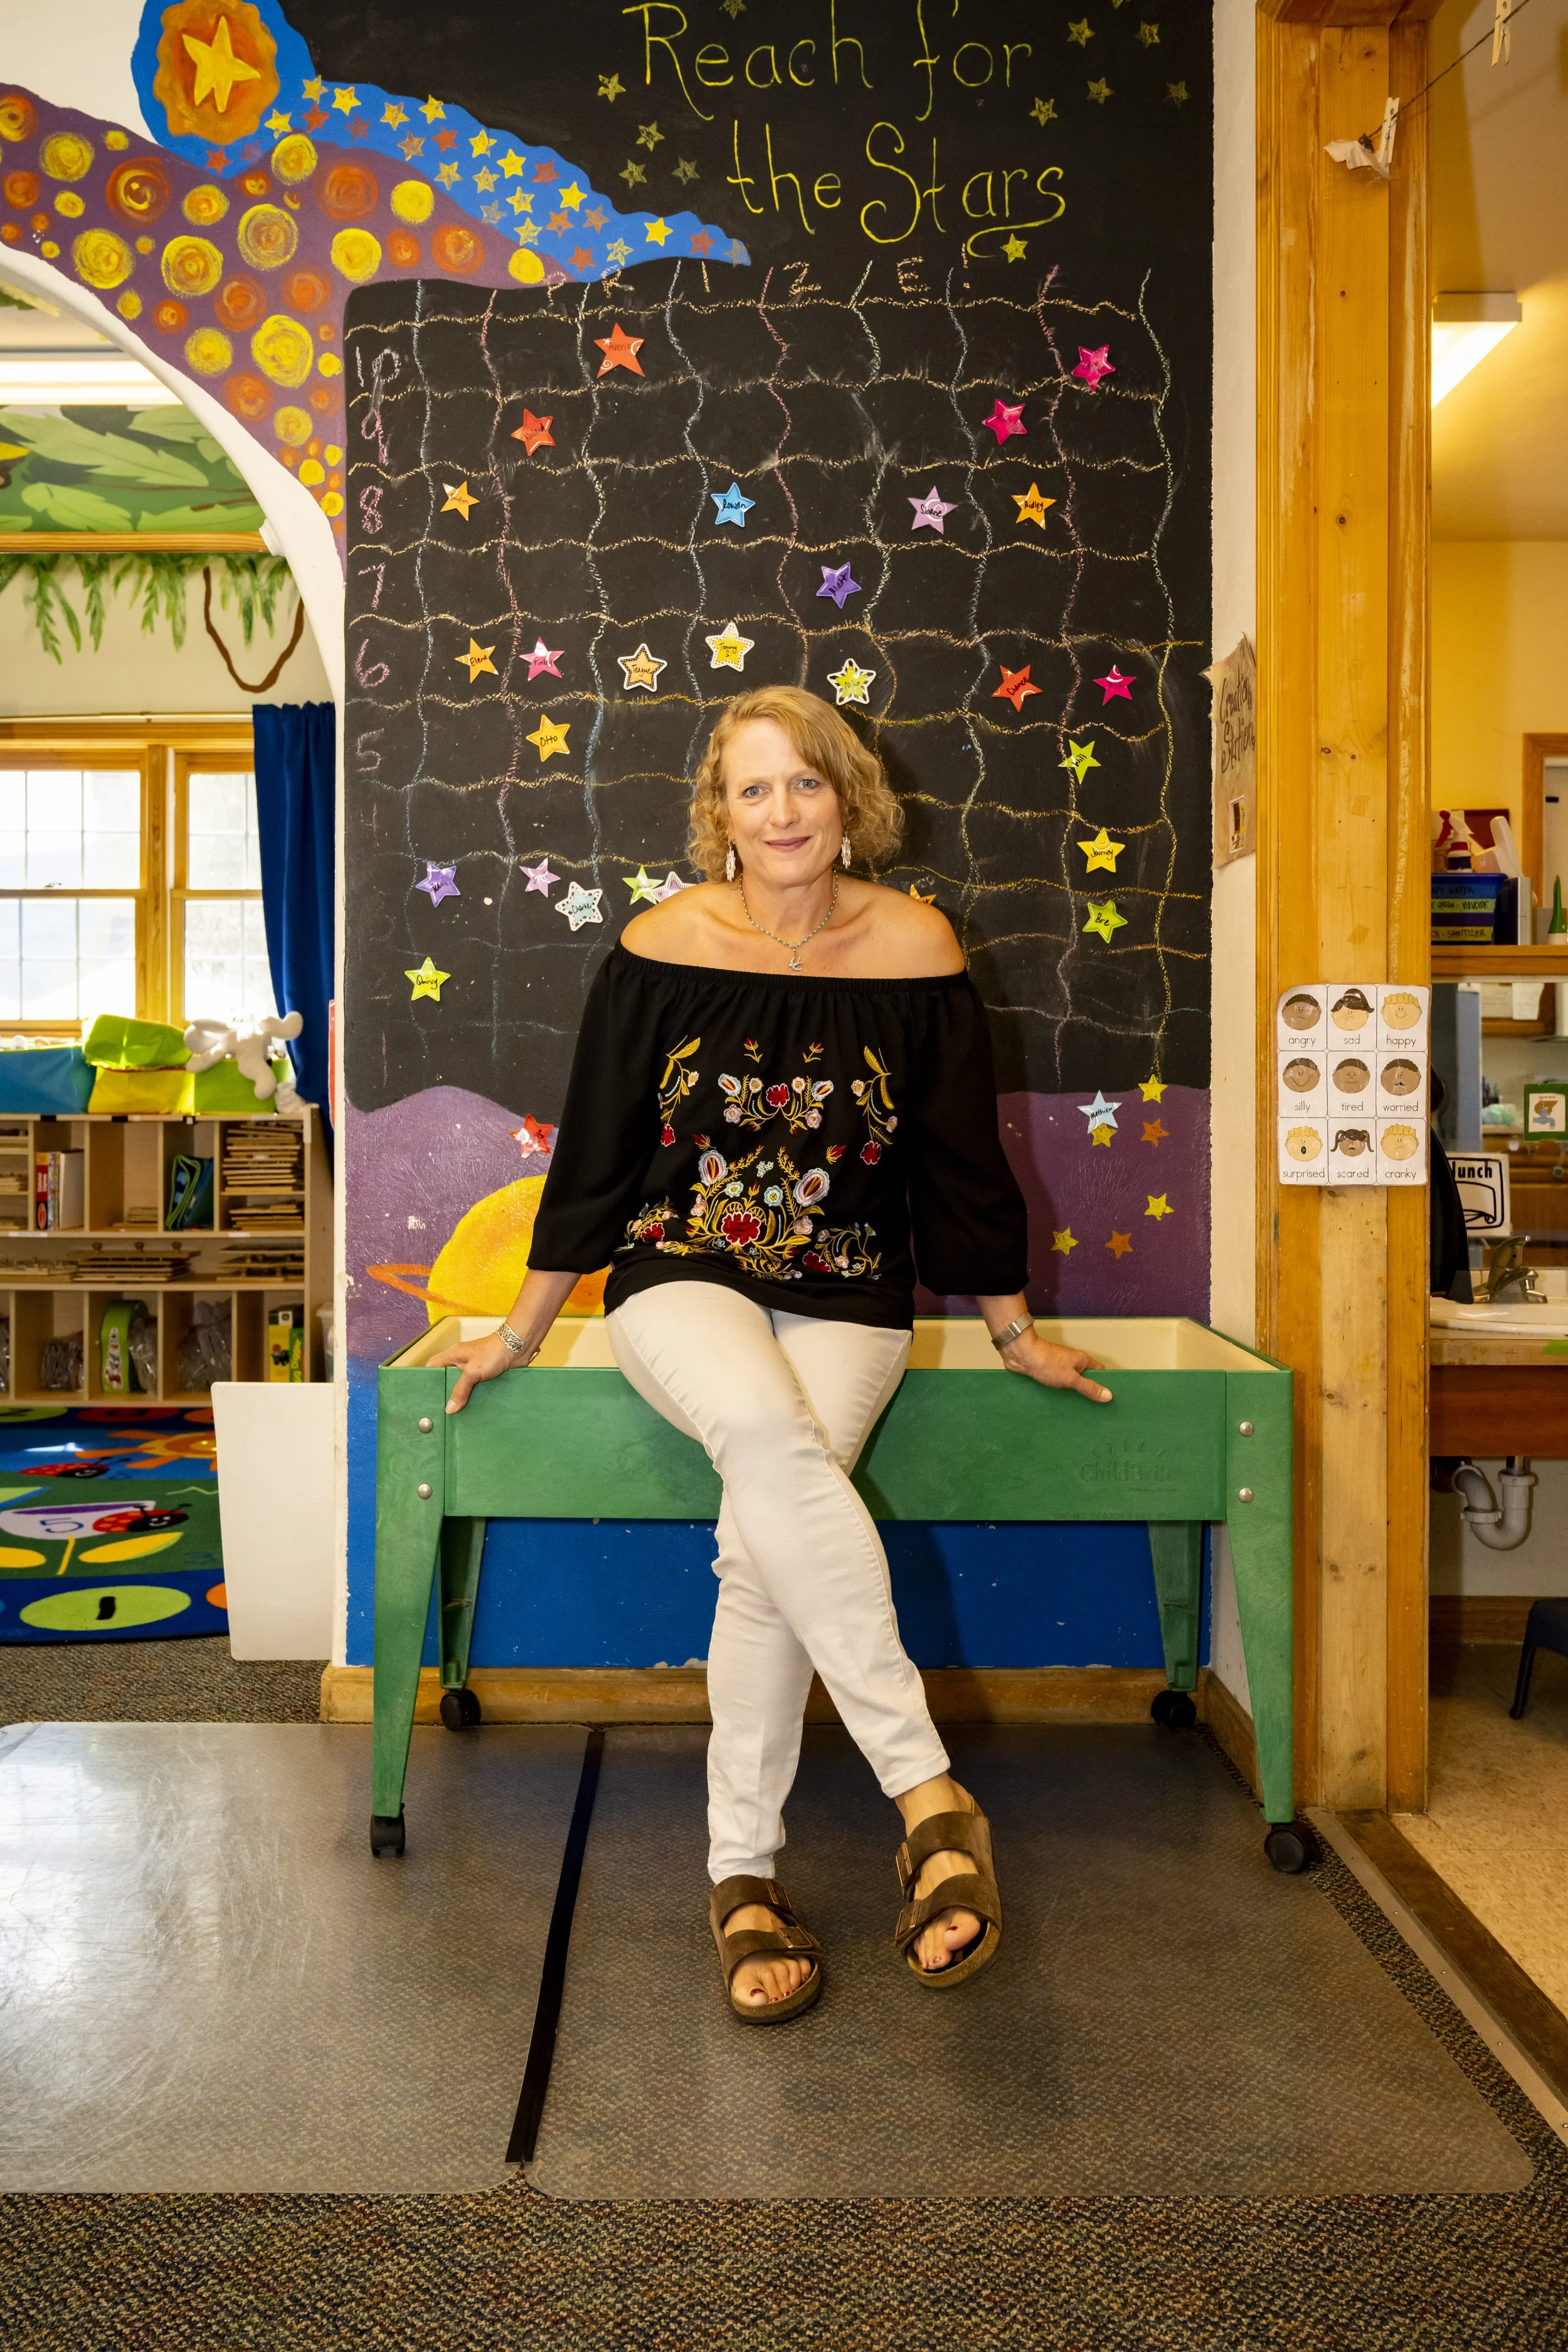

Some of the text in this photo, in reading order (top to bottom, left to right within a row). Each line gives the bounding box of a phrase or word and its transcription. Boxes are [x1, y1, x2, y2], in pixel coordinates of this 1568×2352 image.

[623, 0, 1032, 122] Reach for
[728, 120, 1065, 258] the Stars
[354, 346, 401, 387] 10
[361, 409, 389, 466] 9
[359, 485, 384, 534] 8
[721, 499, 746, 511] Rowan
[1024, 501, 1044, 513] Ridley
[357, 562, 386, 610] 7
[719, 643, 738, 654] Tommy
[354, 638, 390, 689] 6
[1007, 676, 1029, 696] Chance
[539, 735, 558, 747] Otto
[356, 728, 384, 773] 5
[1072, 754, 1087, 767] Will
[1094, 913, 1110, 926] Bre
[1447, 929, 1486, 939] SANITIZER
[416, 975, 438, 990] Quincy
[1288, 1034, 1417, 1049] angry sad happy
[1295, 1100, 1419, 1114] silly tired worried
[1282, 1168, 1417, 1182] surprised scared cranky
[1452, 1159, 1492, 1179] lunch
